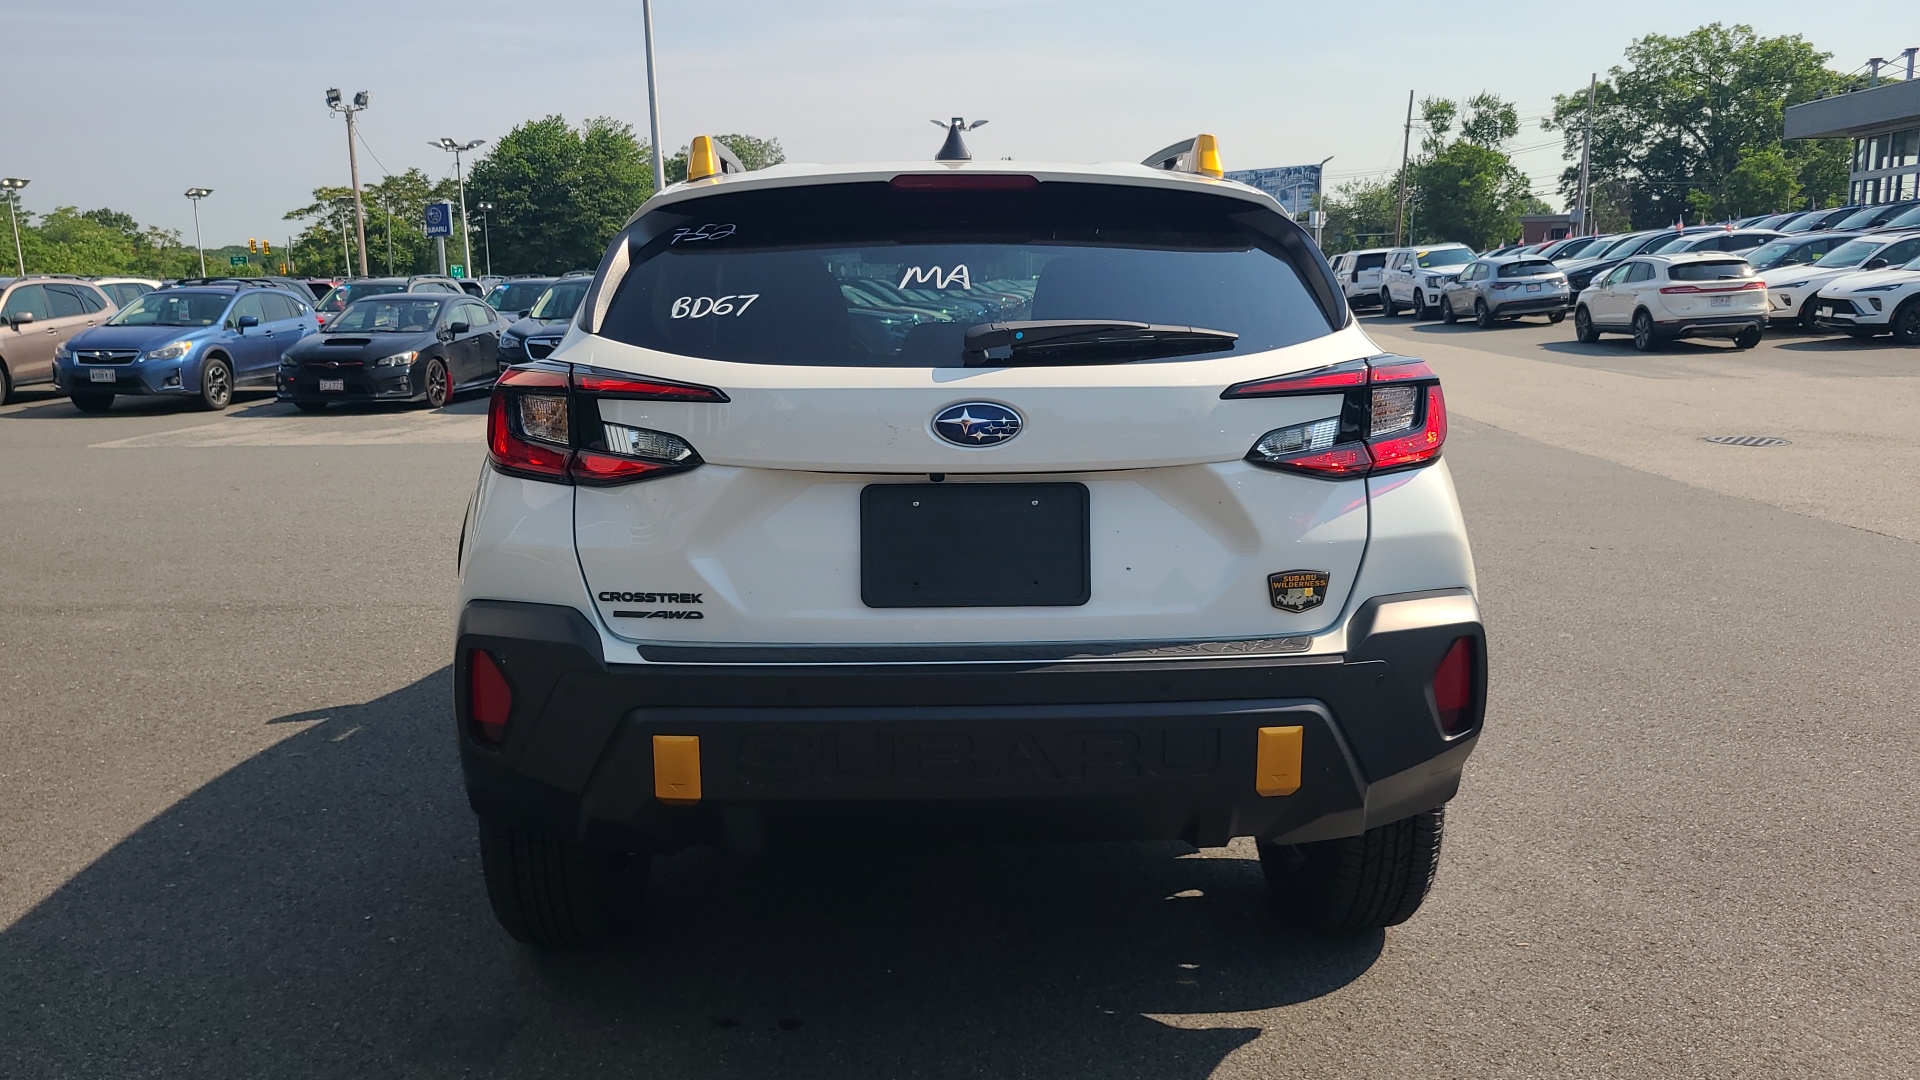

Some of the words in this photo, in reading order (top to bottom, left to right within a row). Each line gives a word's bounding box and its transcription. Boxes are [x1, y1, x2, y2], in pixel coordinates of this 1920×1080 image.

[428, 225, 447, 233] SUBARU
[671, 223, 737, 245] 752
[898, 264, 971, 290] MA
[670, 293, 760, 319] BD67
[1273, 580, 1326, 589] WILDERNESS
[598, 591, 704, 604] CROSSTREK
[646, 610, 704, 620] AWD
[738, 728, 1222, 783] SUBARU
